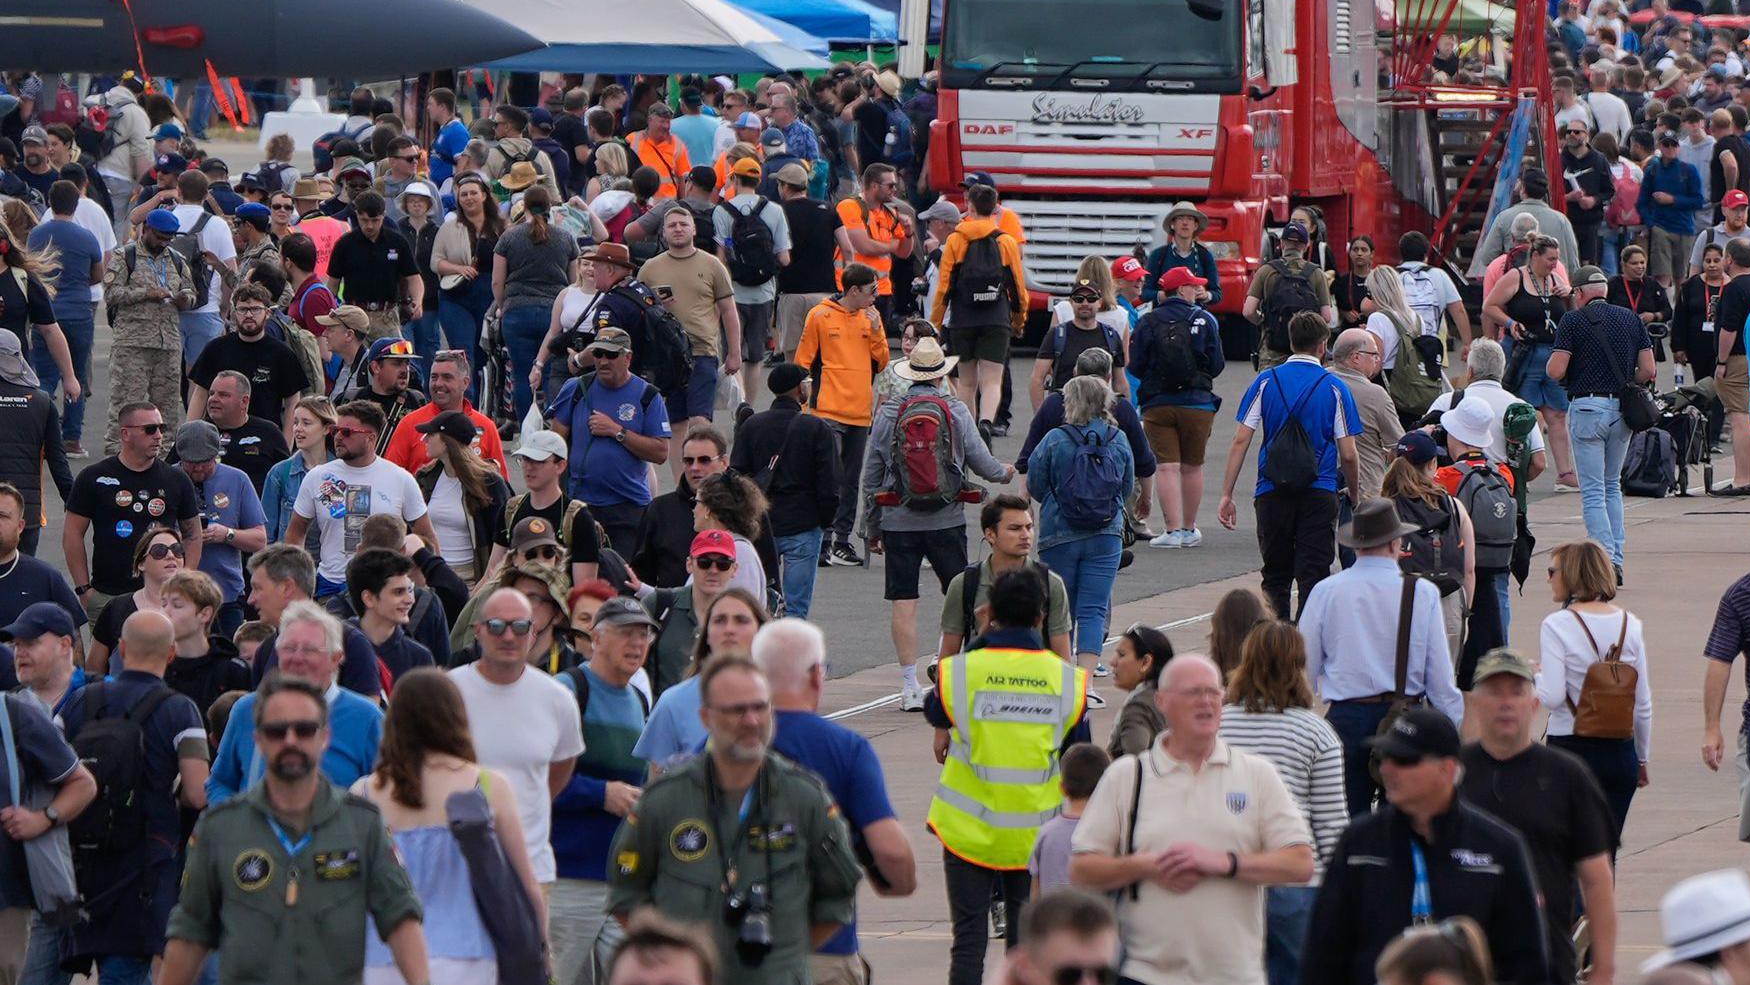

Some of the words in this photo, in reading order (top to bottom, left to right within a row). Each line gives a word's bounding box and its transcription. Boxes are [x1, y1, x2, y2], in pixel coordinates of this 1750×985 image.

[1031, 92, 1144, 122] Simulator
[963, 123, 1014, 136] DAF
[1176, 128, 1214, 139] XF
[985, 675, 1005, 686] AIR
[1008, 676, 1048, 688] TATTOO
